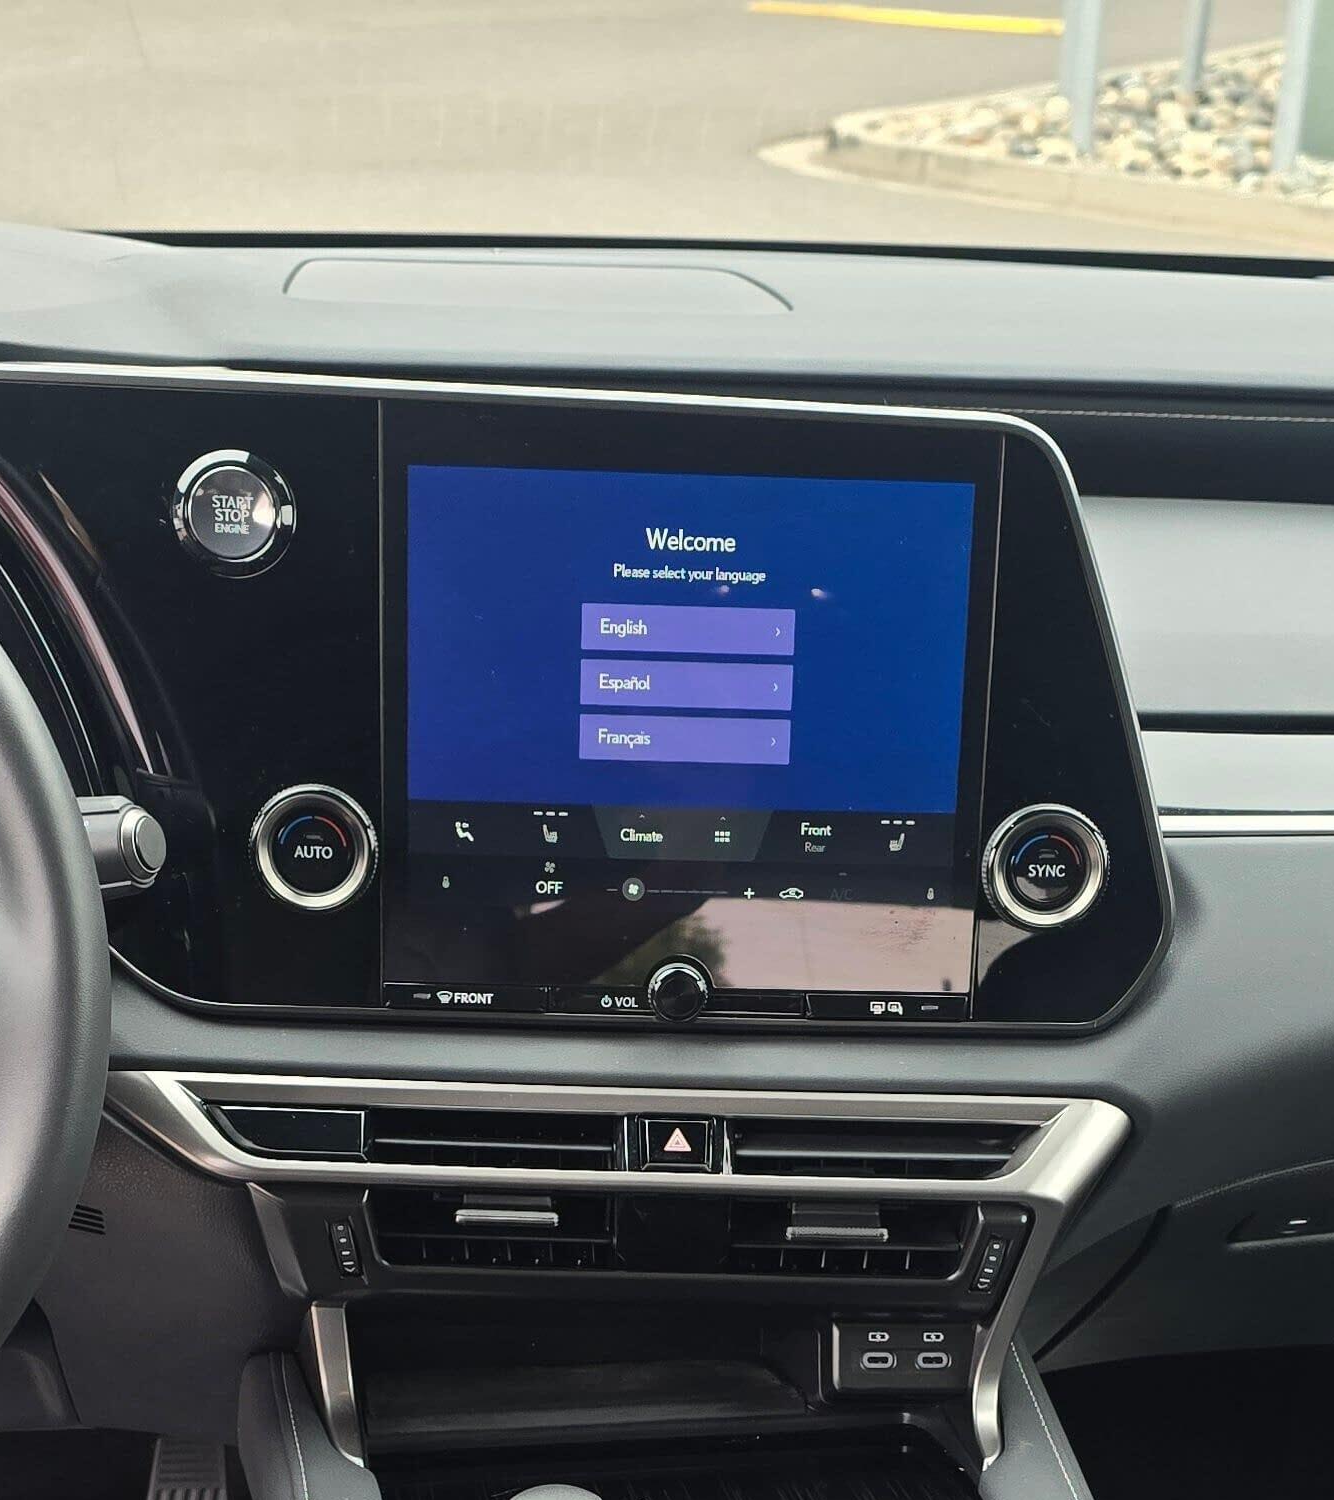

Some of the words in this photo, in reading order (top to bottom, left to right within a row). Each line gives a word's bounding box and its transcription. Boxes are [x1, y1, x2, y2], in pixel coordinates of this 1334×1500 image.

[212, 495, 254, 509] START
[214, 509, 250, 523] STOP
[214, 523, 250, 535] ENGINE
[645, 527, 736, 553] Welcome
[613, 563, 650, 579] Please
[652, 565, 686, 580] select
[687, 569, 714, 583] your
[715, 567, 766, 584] language
[600, 618, 648, 638] English
[599, 673, 650, 693] Español
[598, 728, 651, 749] Français
[620, 828, 664, 843] Climate
[800, 822, 833, 837] Front
[293, 846, 333, 860] AUTO
[804, 842, 826, 853] Rear
[1028, 864, 1066, 878] SYNC
[535, 880, 564, 895] OFF
[453, 992, 494, 1005] FRONT
[614, 996, 639, 1008] VOL
